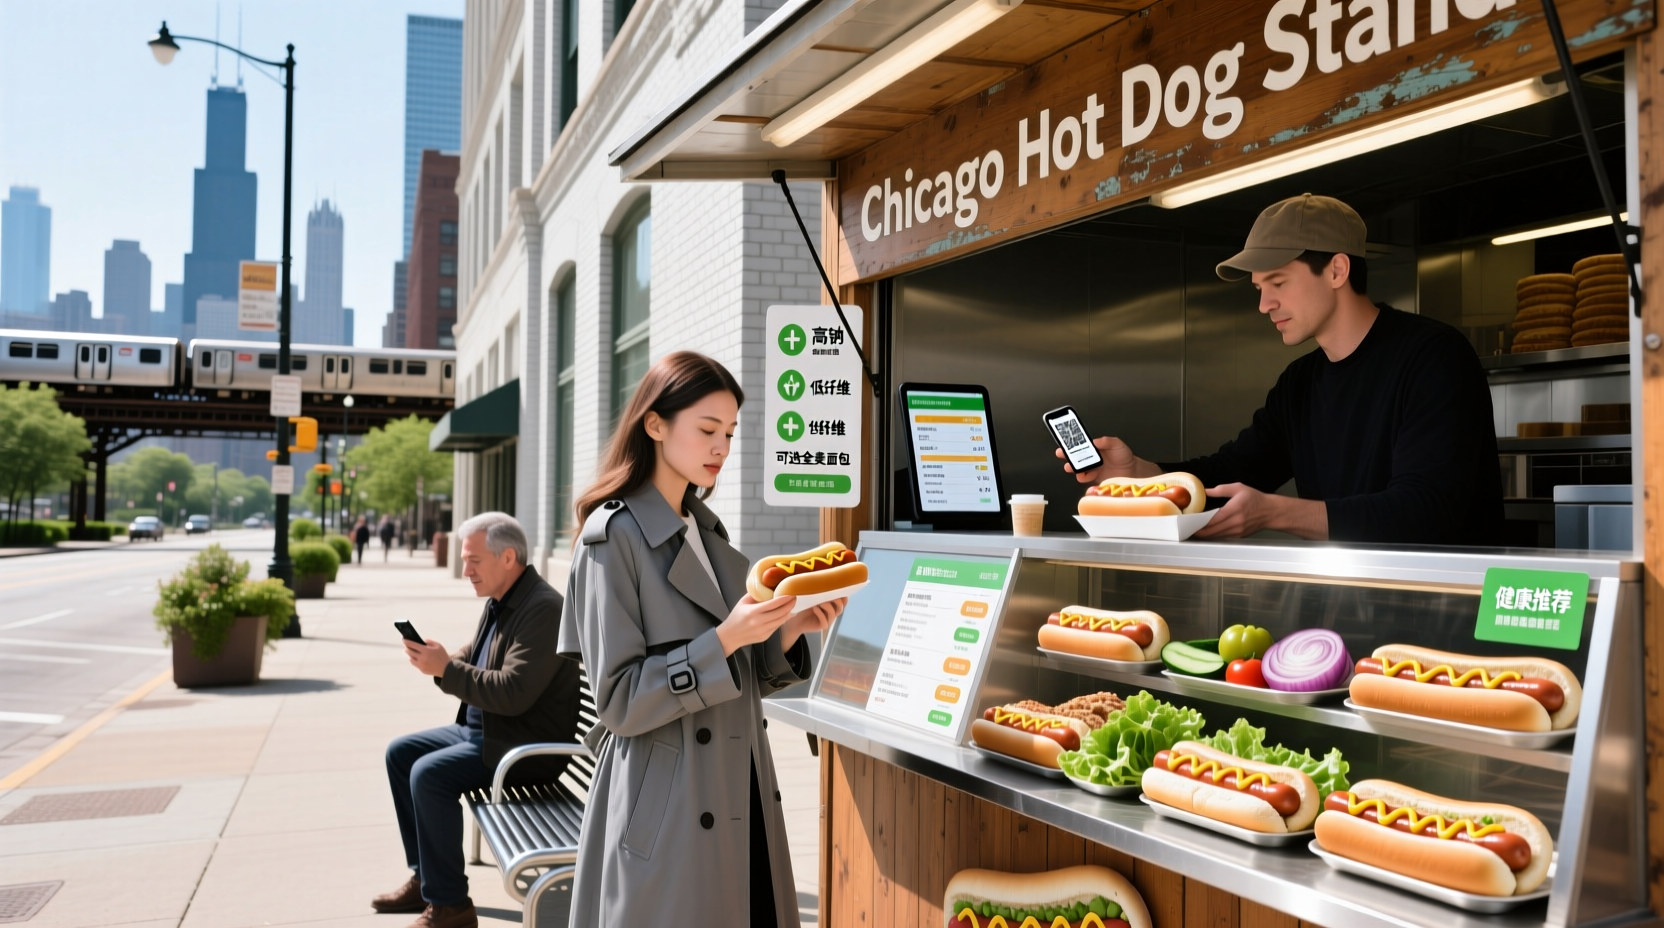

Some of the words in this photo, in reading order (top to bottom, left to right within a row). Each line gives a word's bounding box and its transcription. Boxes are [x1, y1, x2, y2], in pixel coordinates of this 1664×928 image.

[861, 150, 1004, 242] Chicago
[1018, 93, 1105, 187] Hot
[1121, 42, 1245, 148] Dog
[1262, 0, 1517, 91] Stan
[1495, 586, 1573, 614] 健康推荐
